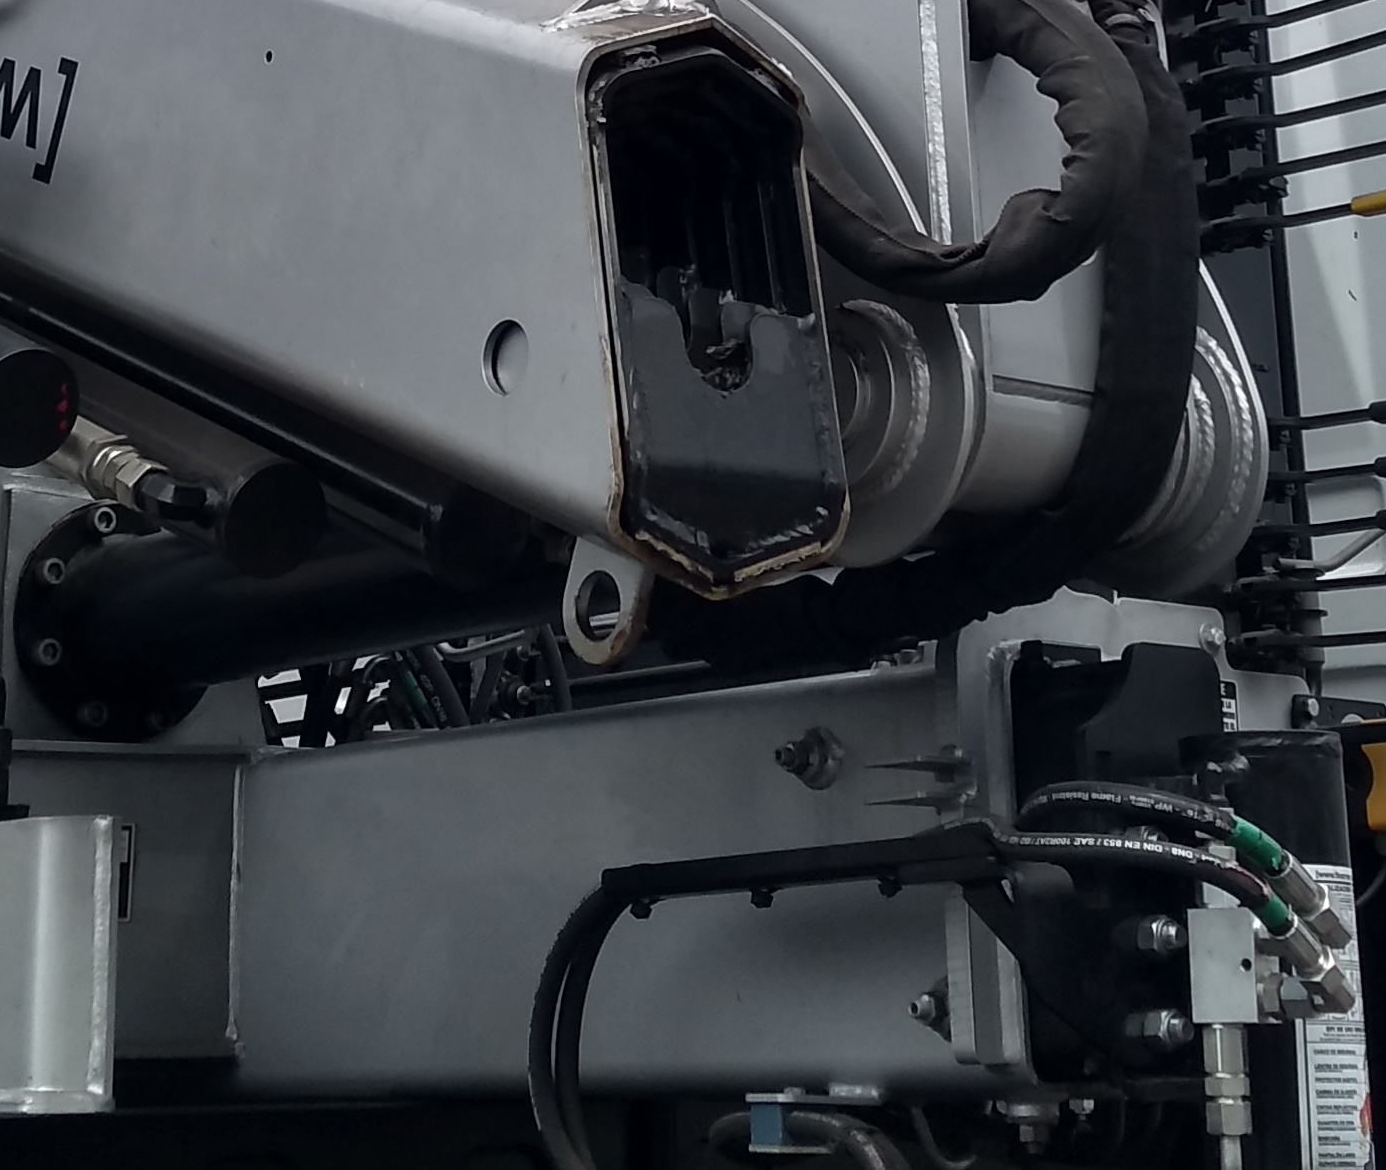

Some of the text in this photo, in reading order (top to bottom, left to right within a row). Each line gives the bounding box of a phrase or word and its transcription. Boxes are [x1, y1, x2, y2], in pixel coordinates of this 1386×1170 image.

[1091, 792, 1122, 804] Flame
[1073, 837, 1096, 847] SAE
[1103, 838, 1122, 848] 853
[1124, 840, 1141, 850] EN
[1143, 840, 1163, 853] DIN
